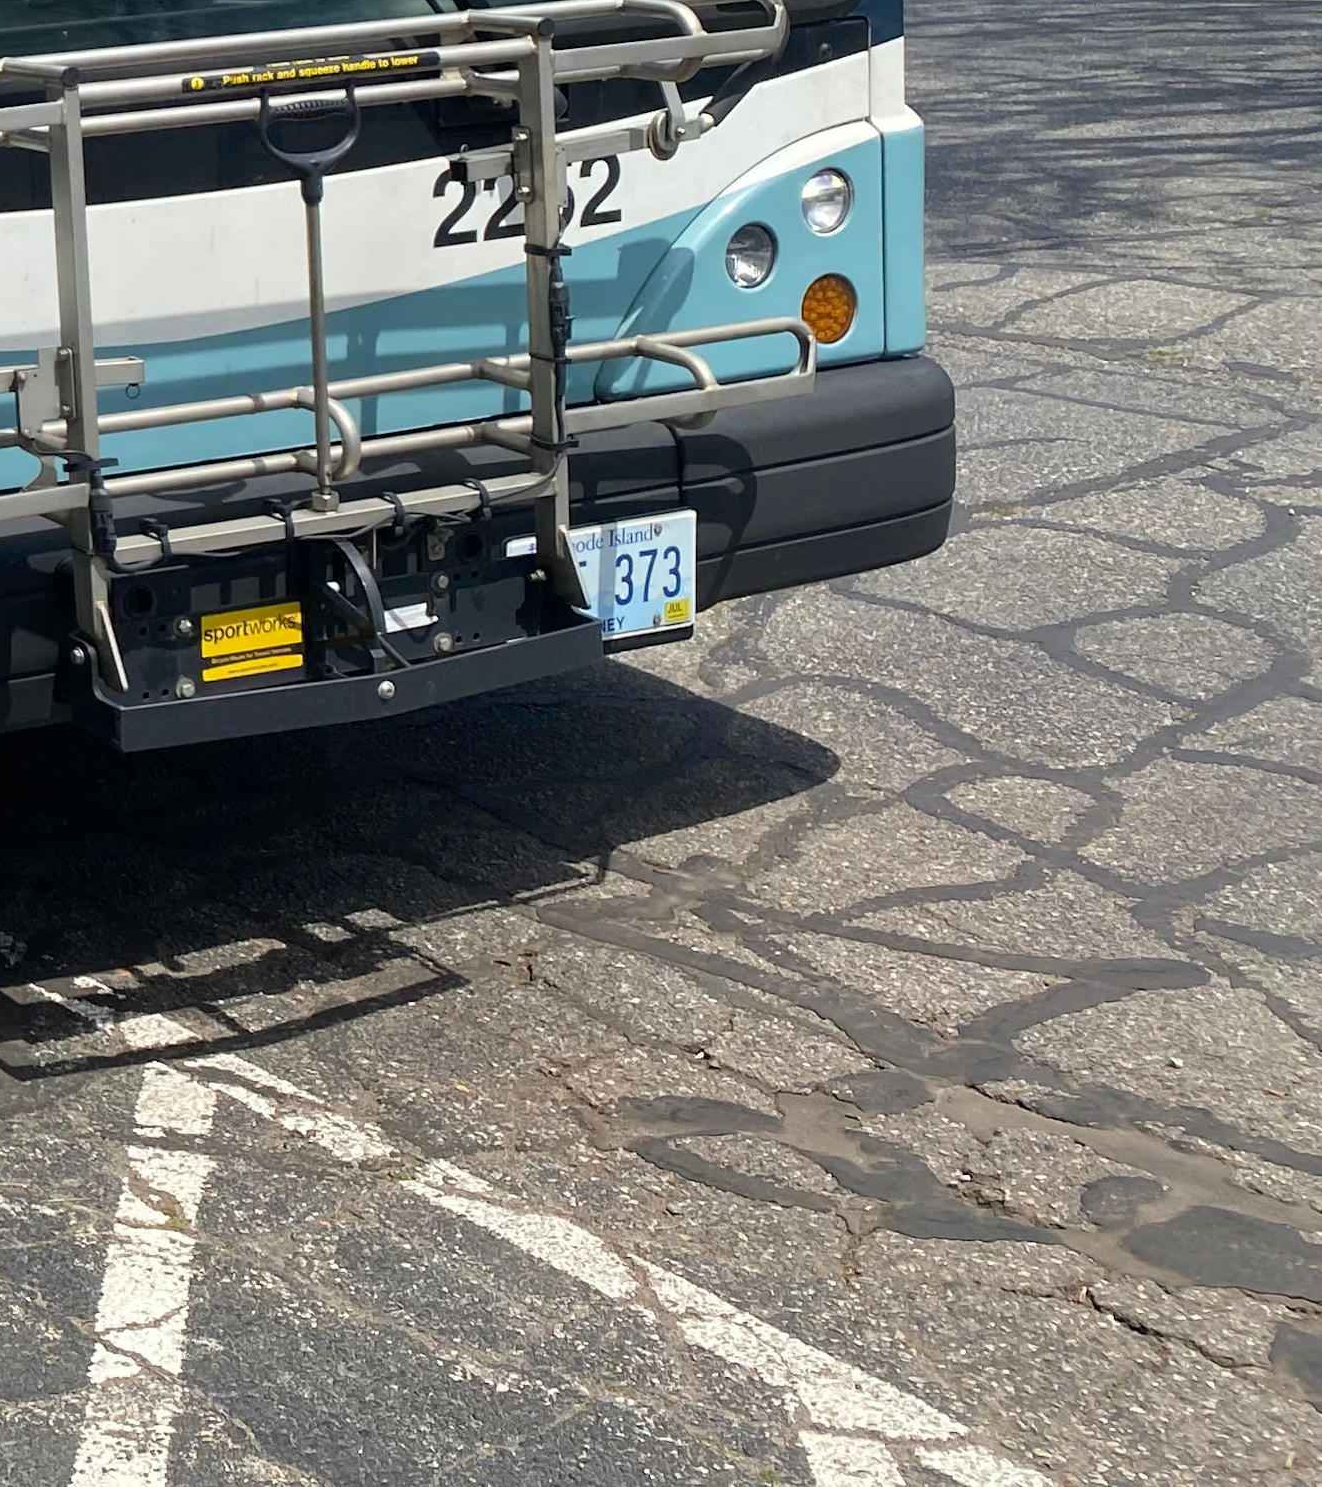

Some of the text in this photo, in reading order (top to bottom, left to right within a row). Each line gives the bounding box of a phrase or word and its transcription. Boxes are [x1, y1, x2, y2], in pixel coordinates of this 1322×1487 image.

[222, 73, 249, 85] Push
[252, 71, 274, 82] rack
[277, 68, 296, 79] and
[298, 65, 340, 78] squeeze
[342, 59, 376, 72] handle
[378, 57, 389, 68] to
[390, 55, 418, 67] lower
[609, 523, 653, 547] Island
[203, 614, 296, 645] sportworks
